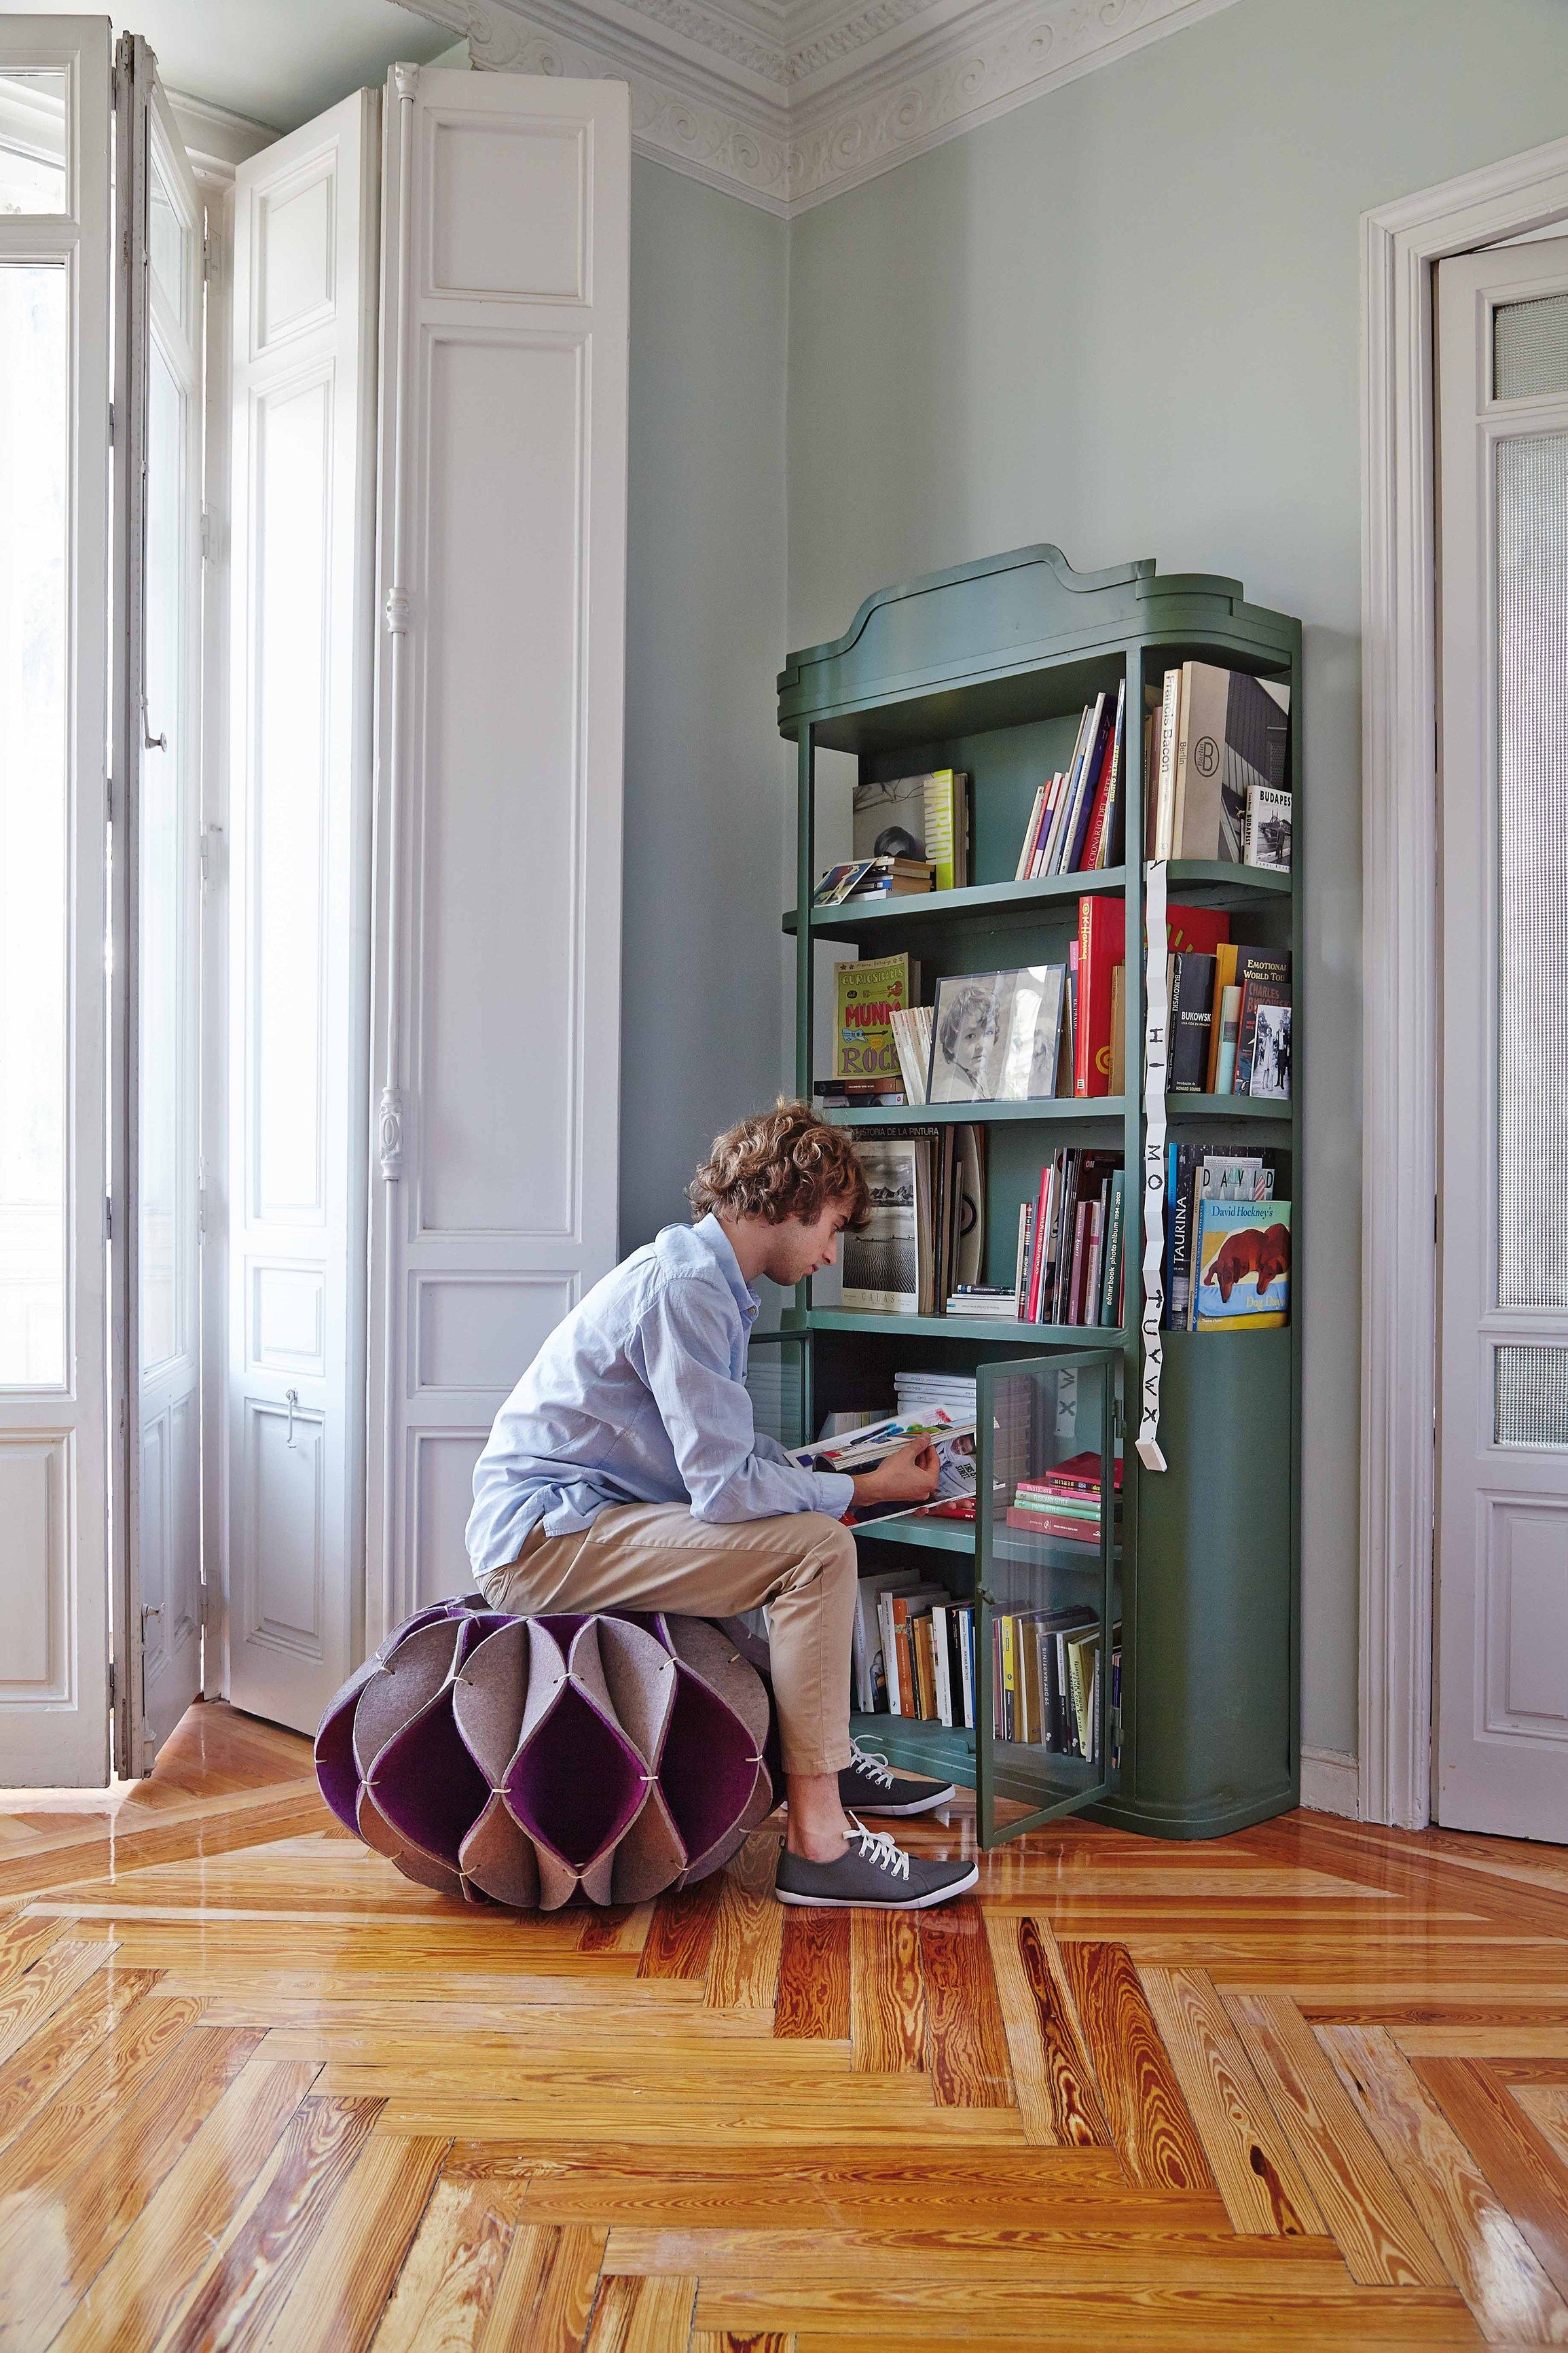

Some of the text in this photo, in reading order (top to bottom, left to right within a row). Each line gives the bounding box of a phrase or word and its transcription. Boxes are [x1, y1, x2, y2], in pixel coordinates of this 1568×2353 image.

[1163, 675, 1175, 725] Francis
[1161, 729, 1173, 774] Bacon
[1260, 790, 1292, 807] BUDAPES
[1098, 802, 1107, 817] DEL
[842, 968, 903, 986] CURIOSIDADES
[1243, 970, 1285, 982] WORLD TOU
[1172, 974, 1180, 1011] BUKOWSKI
[1182, 1011, 1211, 1022] BUKOWSK
[1149, 1028, 1163, 1043] H
[842, 1044, 900, 1073] ROCK
[856, 1127, 939, 1136] HISTORIA DE LA PINTURA
[1148, 1145, 1161, 1161] M
[1203, 1168, 1274, 1189] DAVID
[1211, 1206, 1273, 1220] David Hockney's
[1173, 1196, 1187, 1264] TAURINA
[1148, 1289, 1163, 1308] T
[1245, 1295, 1264, 1311] Dog
[1143, 1319, 1158, 1336] U
[1145, 1376, 1158, 1397] W
[1142, 1407, 1158, 1423] X
[955, 1465, 971, 1479] STREET
[963, 1463, 974, 1473] THIS
[1027, 1486, 1052, 1494] BARCELONA
[1054, 1479, 1074, 1488] BERLIN
[1032, 1503, 1060, 1513] PARIS STYLE
[1033, 1494, 1069, 1506] TUSCANY STYLE
[1045, 1697, 1050, 1706] 29
